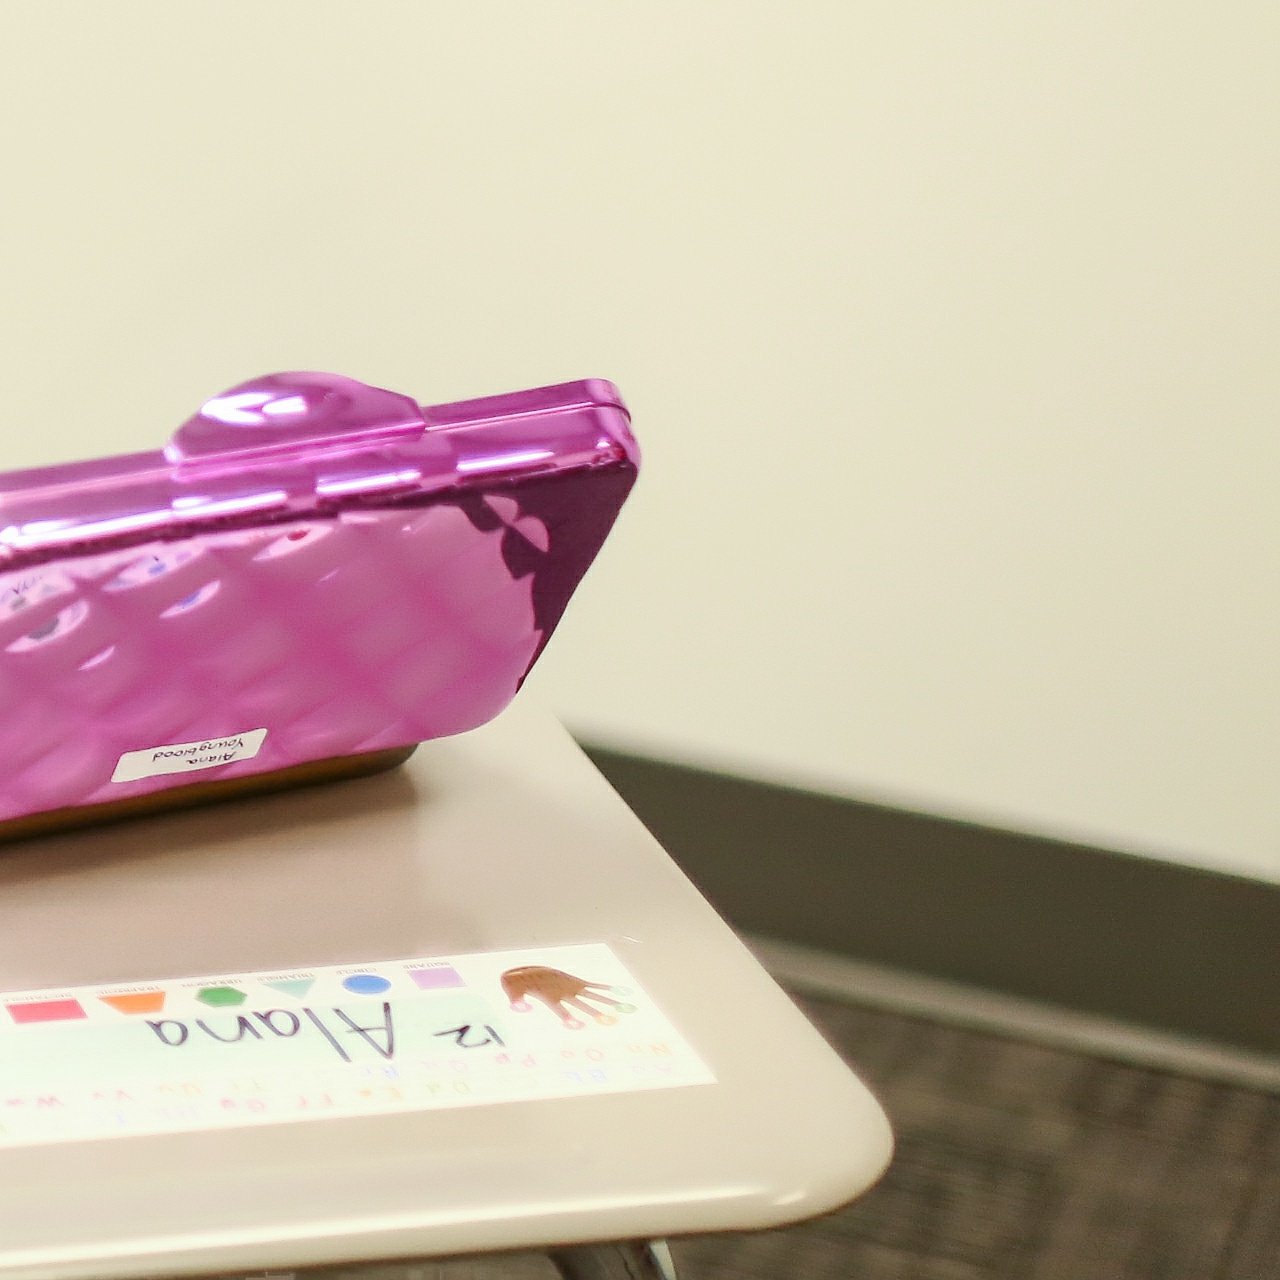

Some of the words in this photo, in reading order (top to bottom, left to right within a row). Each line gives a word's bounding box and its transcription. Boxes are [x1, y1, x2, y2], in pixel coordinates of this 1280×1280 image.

[152, 737, 244, 762] Youngblood
[186, 751, 237, 765] Alana
[143, 1001, 396, 1064] Alana
[432, 1023, 506, 1049] 12
